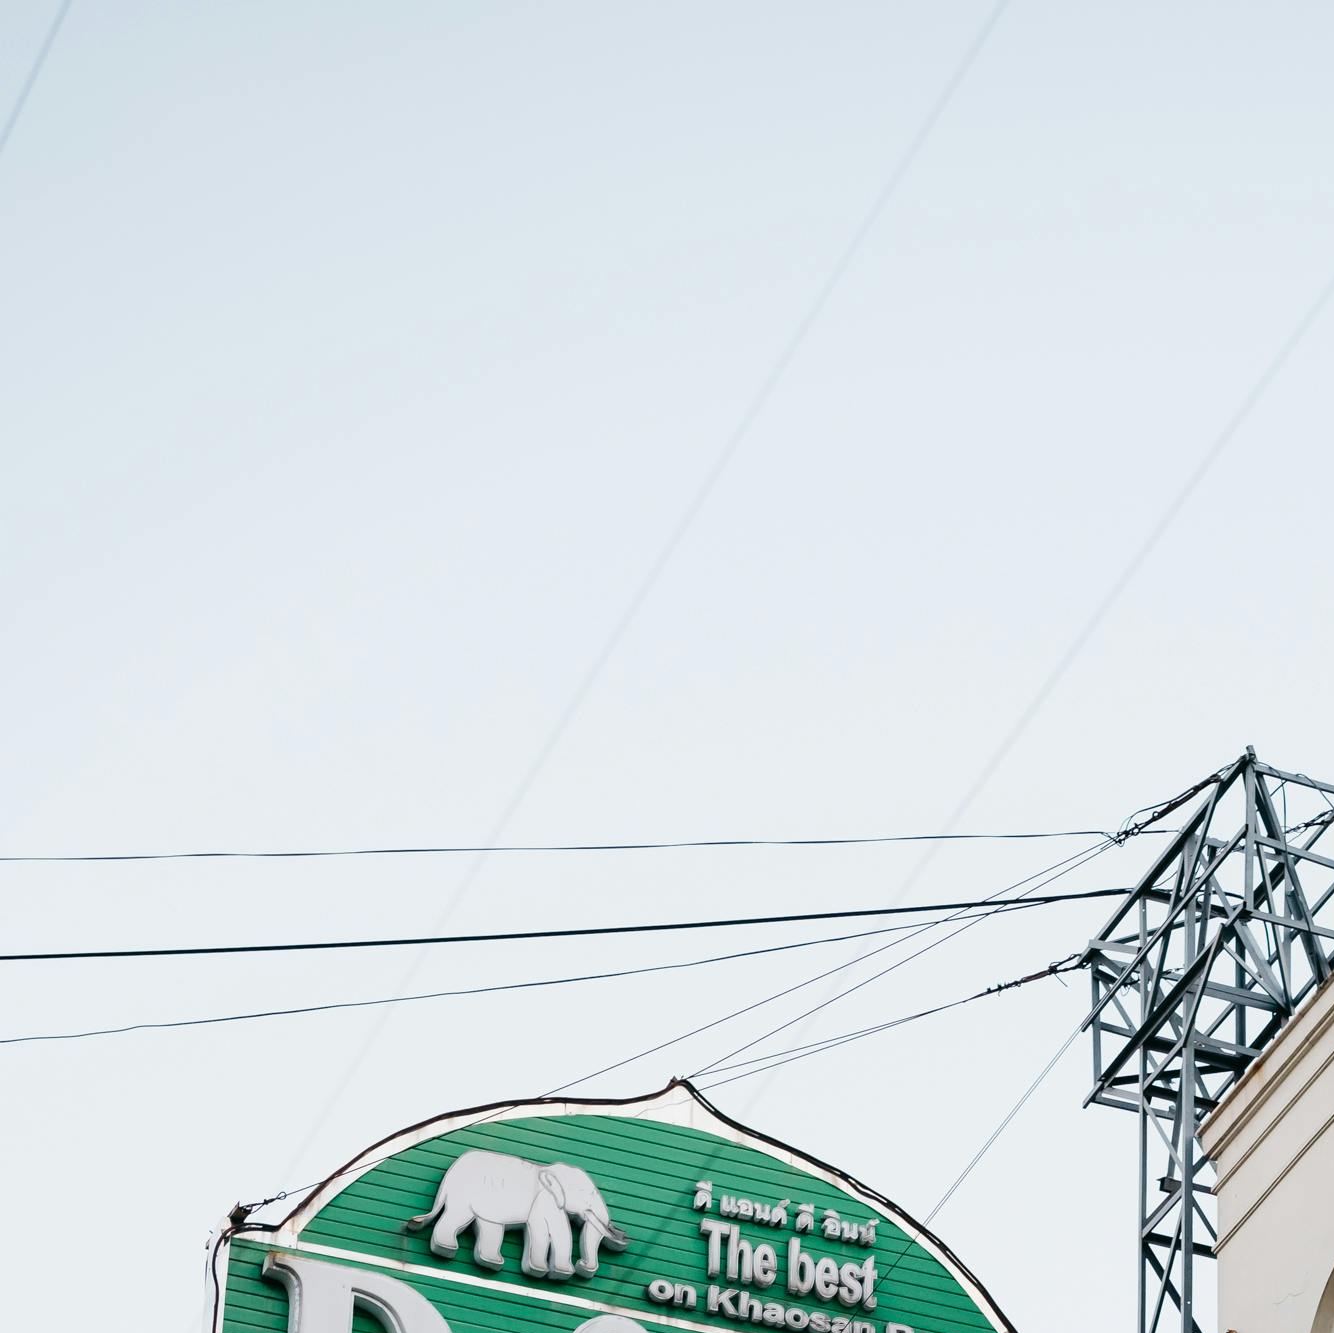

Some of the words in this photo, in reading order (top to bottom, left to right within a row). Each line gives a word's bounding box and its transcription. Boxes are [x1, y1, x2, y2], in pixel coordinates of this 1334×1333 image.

[648, 1278, 698, 1308] on
[699, 1217, 778, 1288] The
[788, 1236, 879, 1310] best
